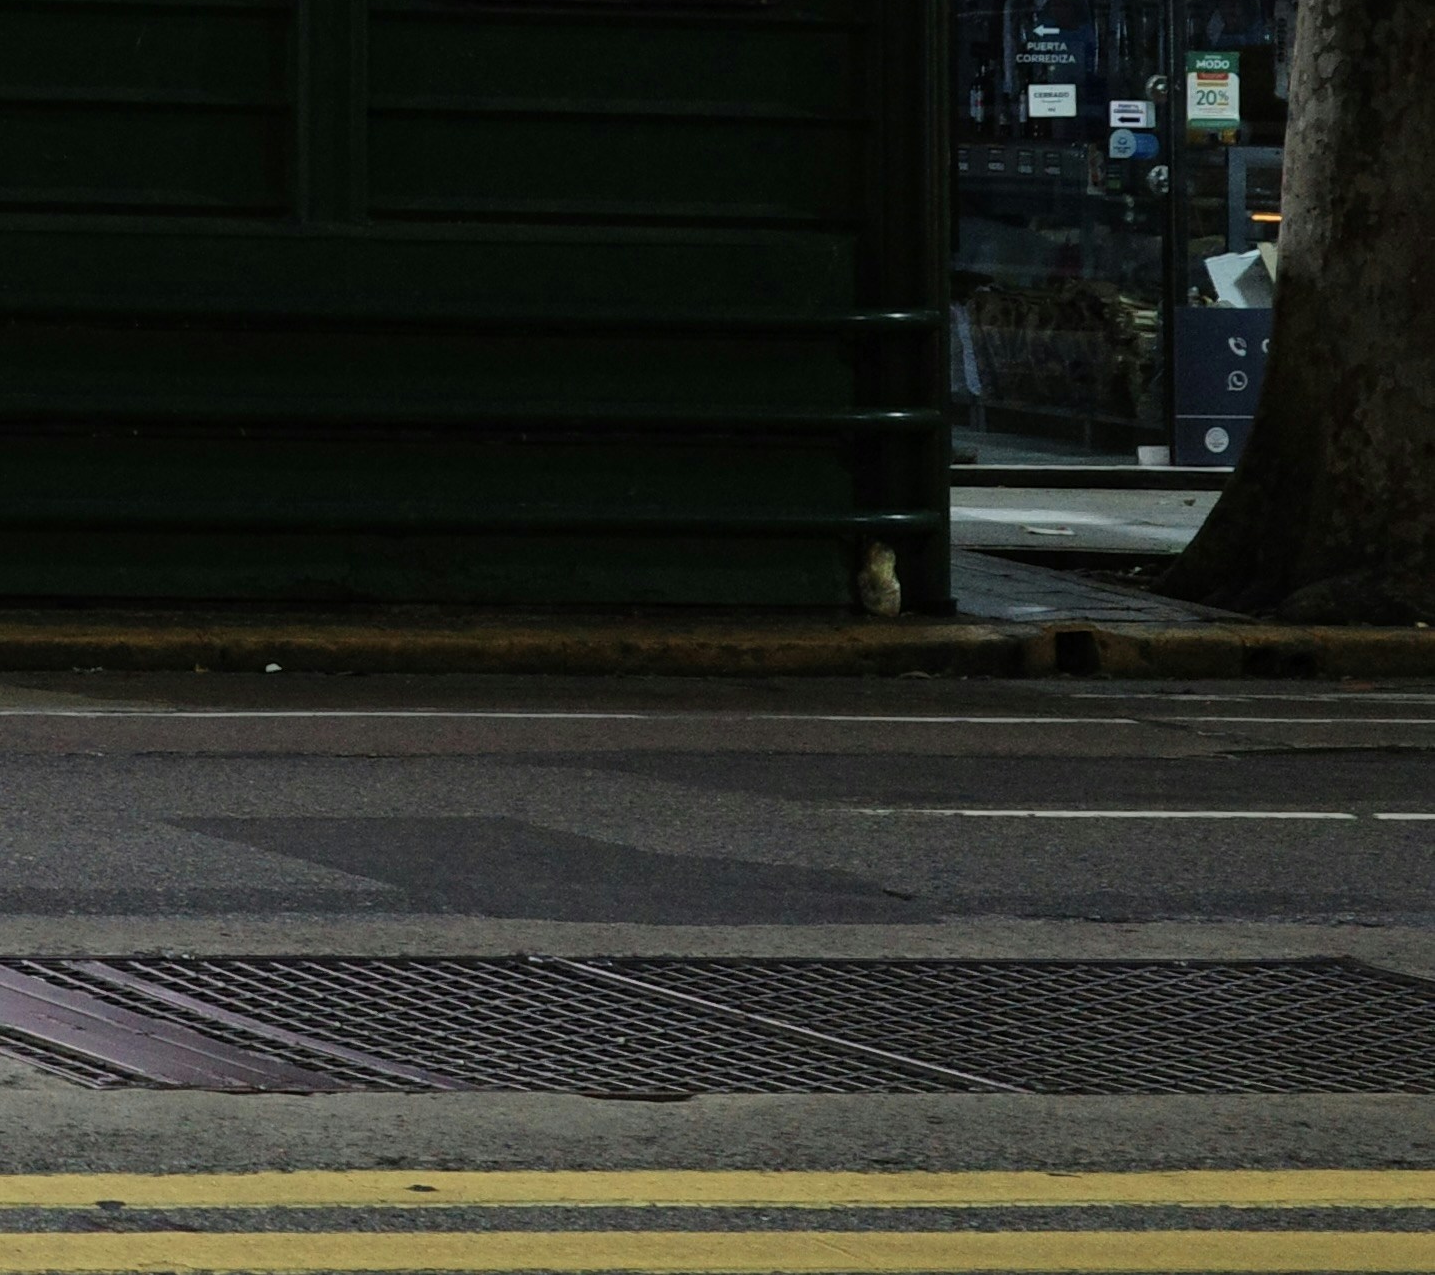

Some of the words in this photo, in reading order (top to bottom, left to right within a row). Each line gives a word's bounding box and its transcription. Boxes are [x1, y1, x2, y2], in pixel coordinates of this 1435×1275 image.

[1027, 41, 1068, 51] PUERTA
[1016, 54, 1076, 63] CORREDIZA
[1195, 59, 1230, 69] MODO
[1196, 89, 1230, 106] 20%
